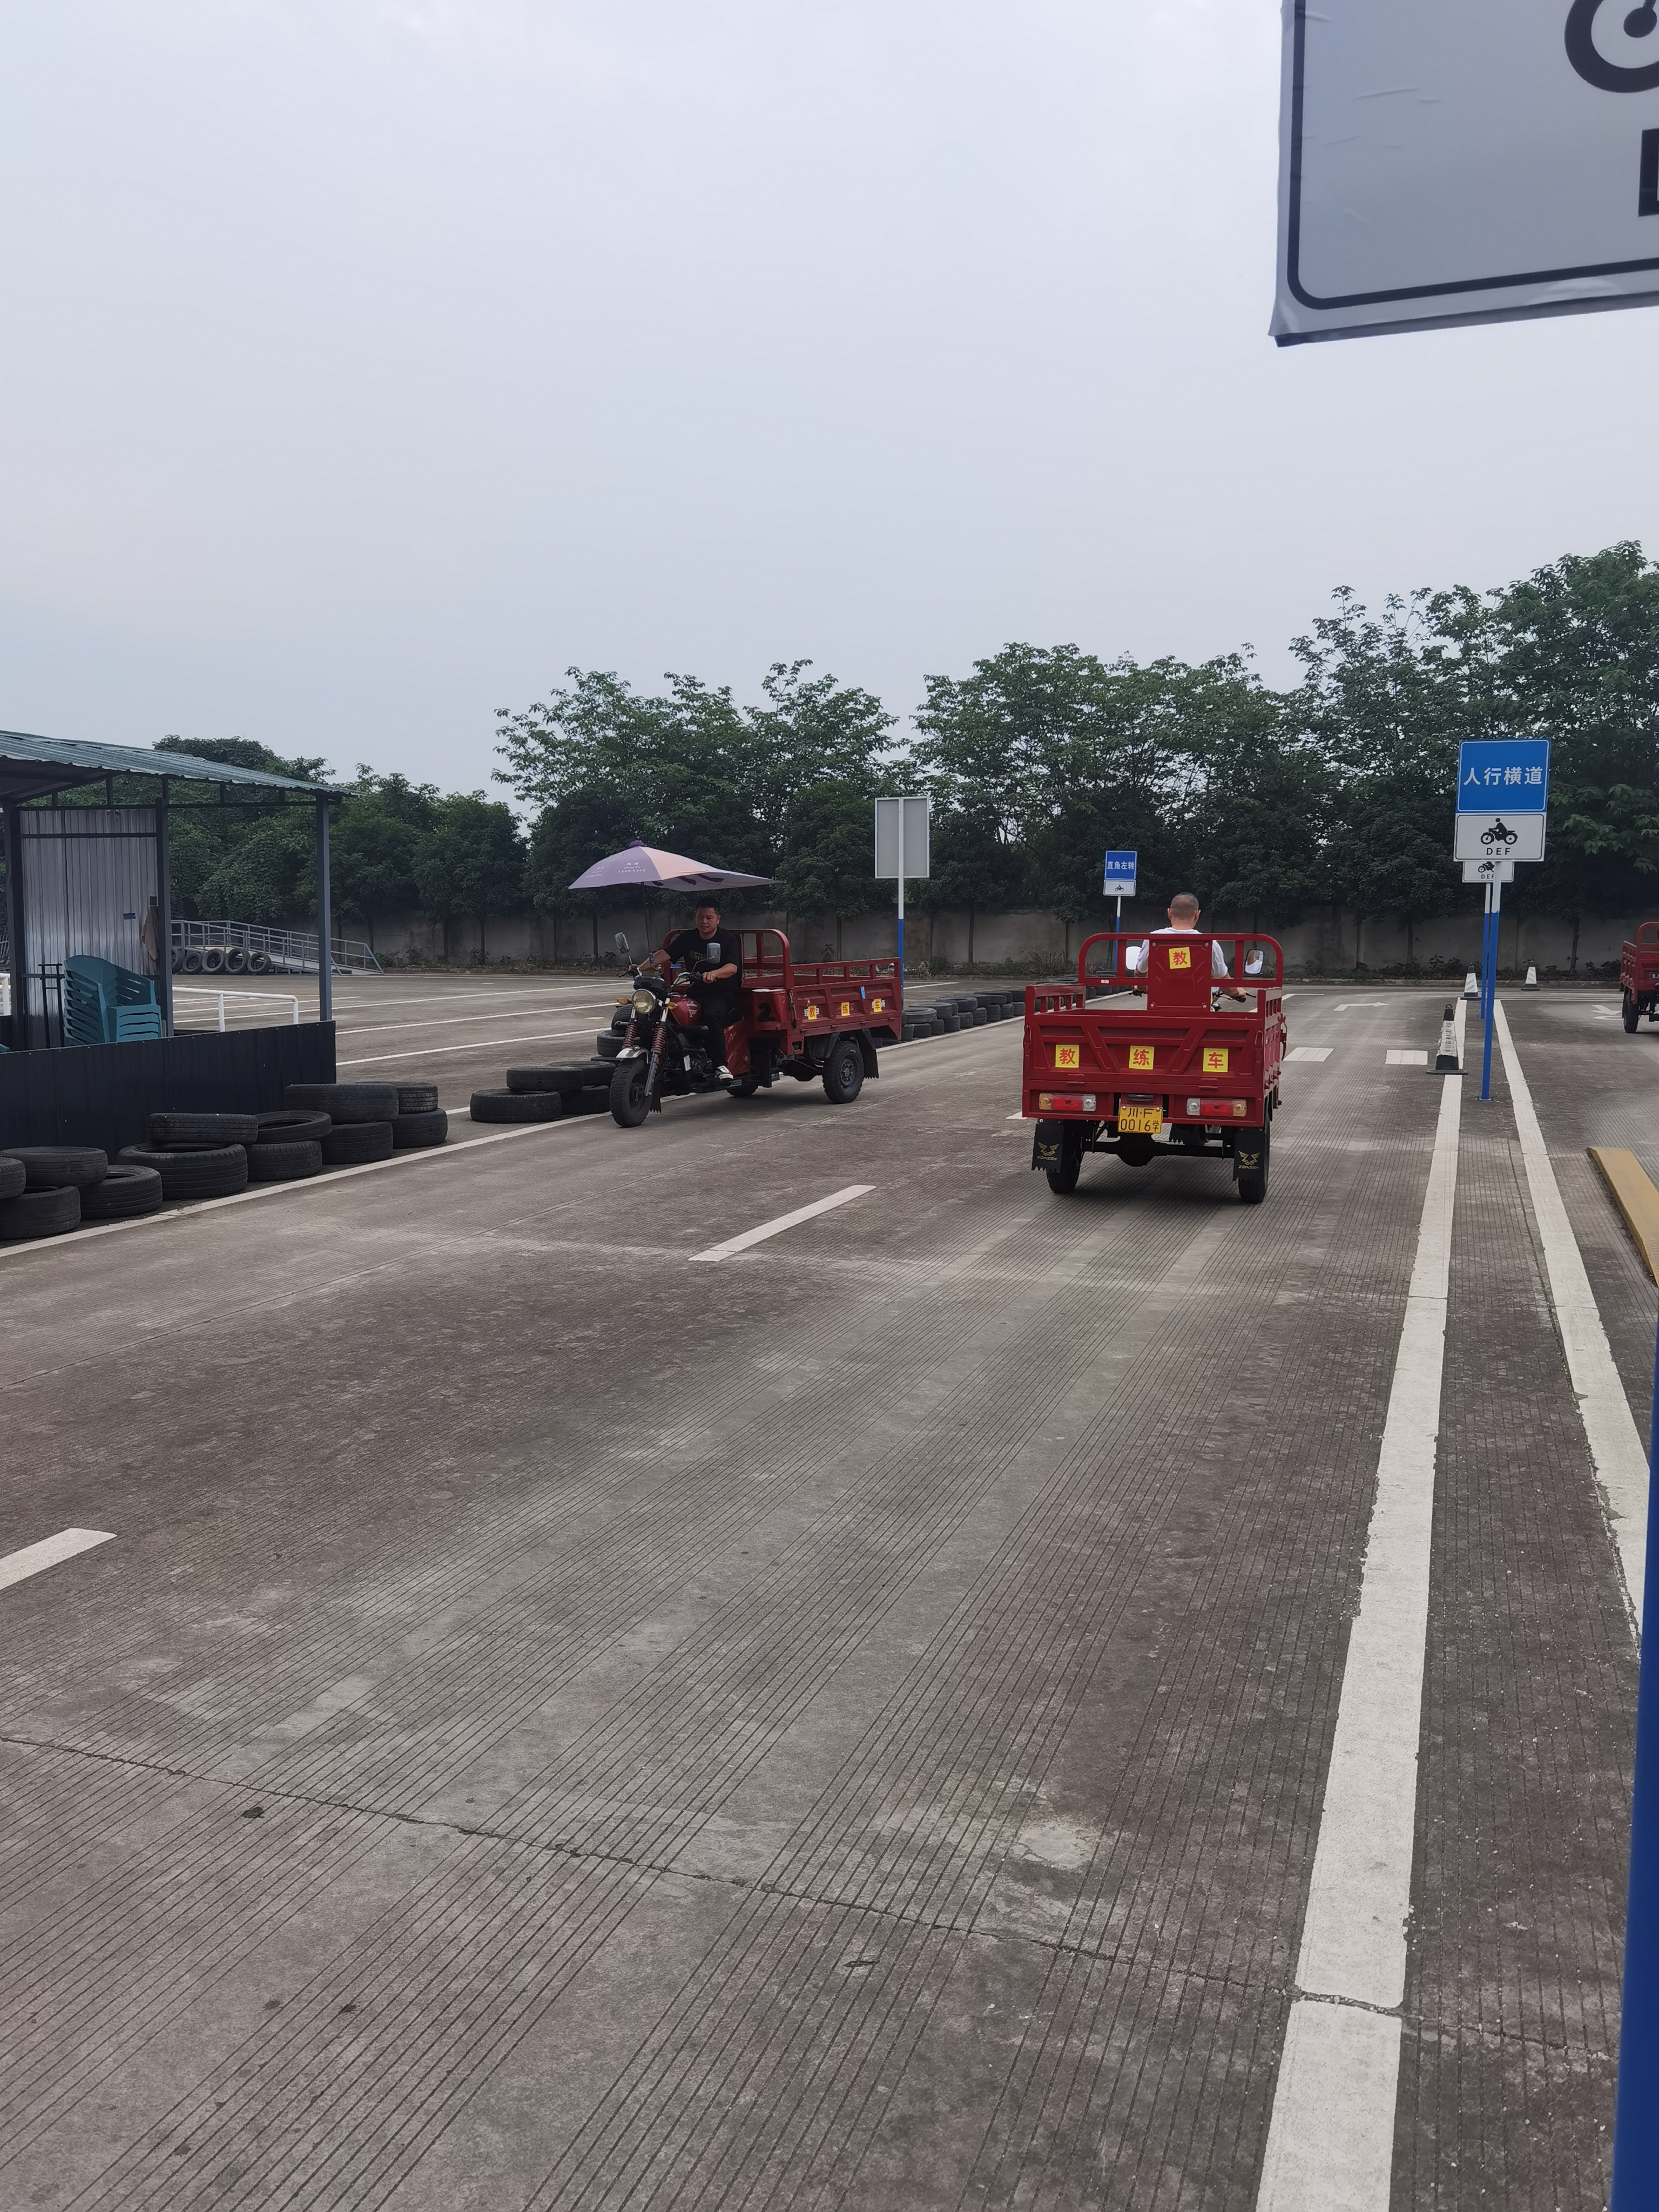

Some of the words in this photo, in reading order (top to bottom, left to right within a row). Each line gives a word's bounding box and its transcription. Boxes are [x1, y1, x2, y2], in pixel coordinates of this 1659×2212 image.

[1463, 766, 1543, 786] 人行横道
[1107, 861, 1135, 870] 直角左转
[1172, 950, 1187, 966] 教
